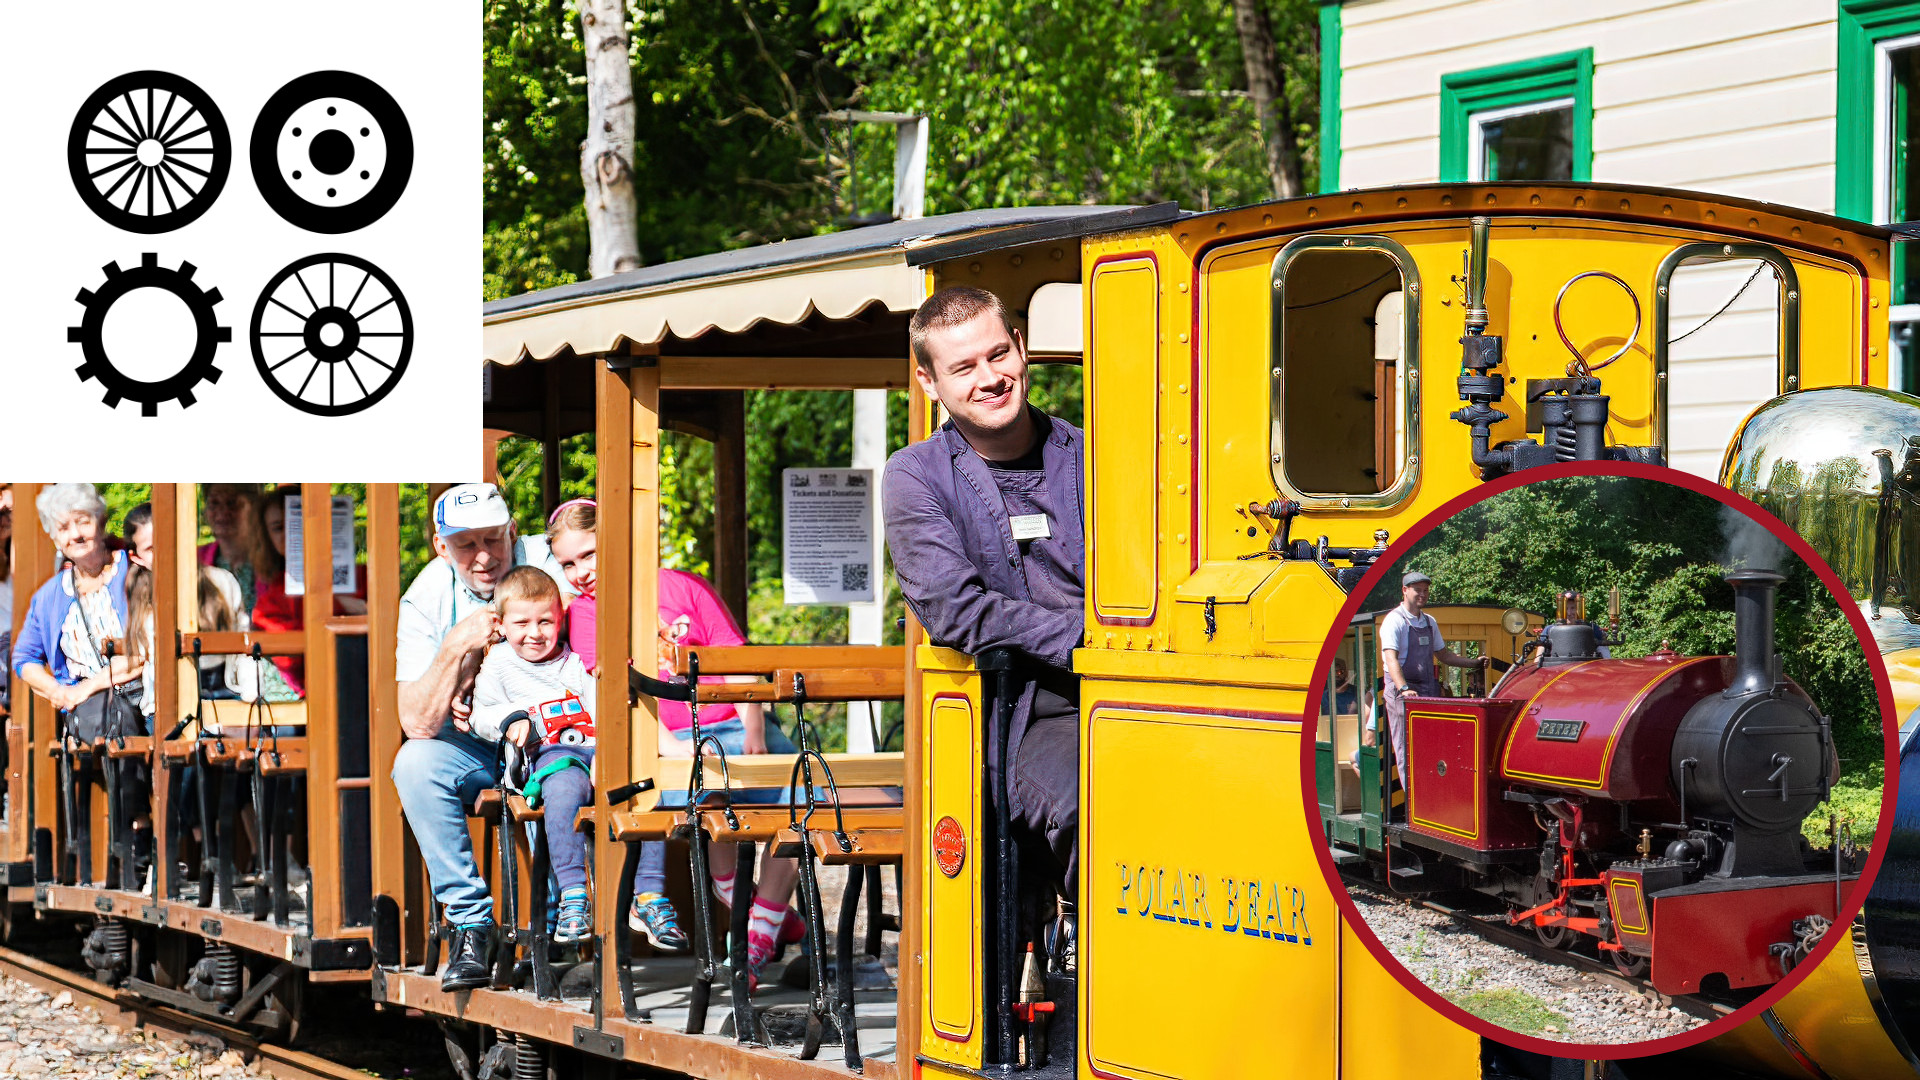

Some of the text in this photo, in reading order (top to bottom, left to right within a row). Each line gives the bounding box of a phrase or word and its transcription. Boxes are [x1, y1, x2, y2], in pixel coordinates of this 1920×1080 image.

[1540, 722, 1579, 736] PETER
[1116, 862, 1312, 946] POLAR BEAR
